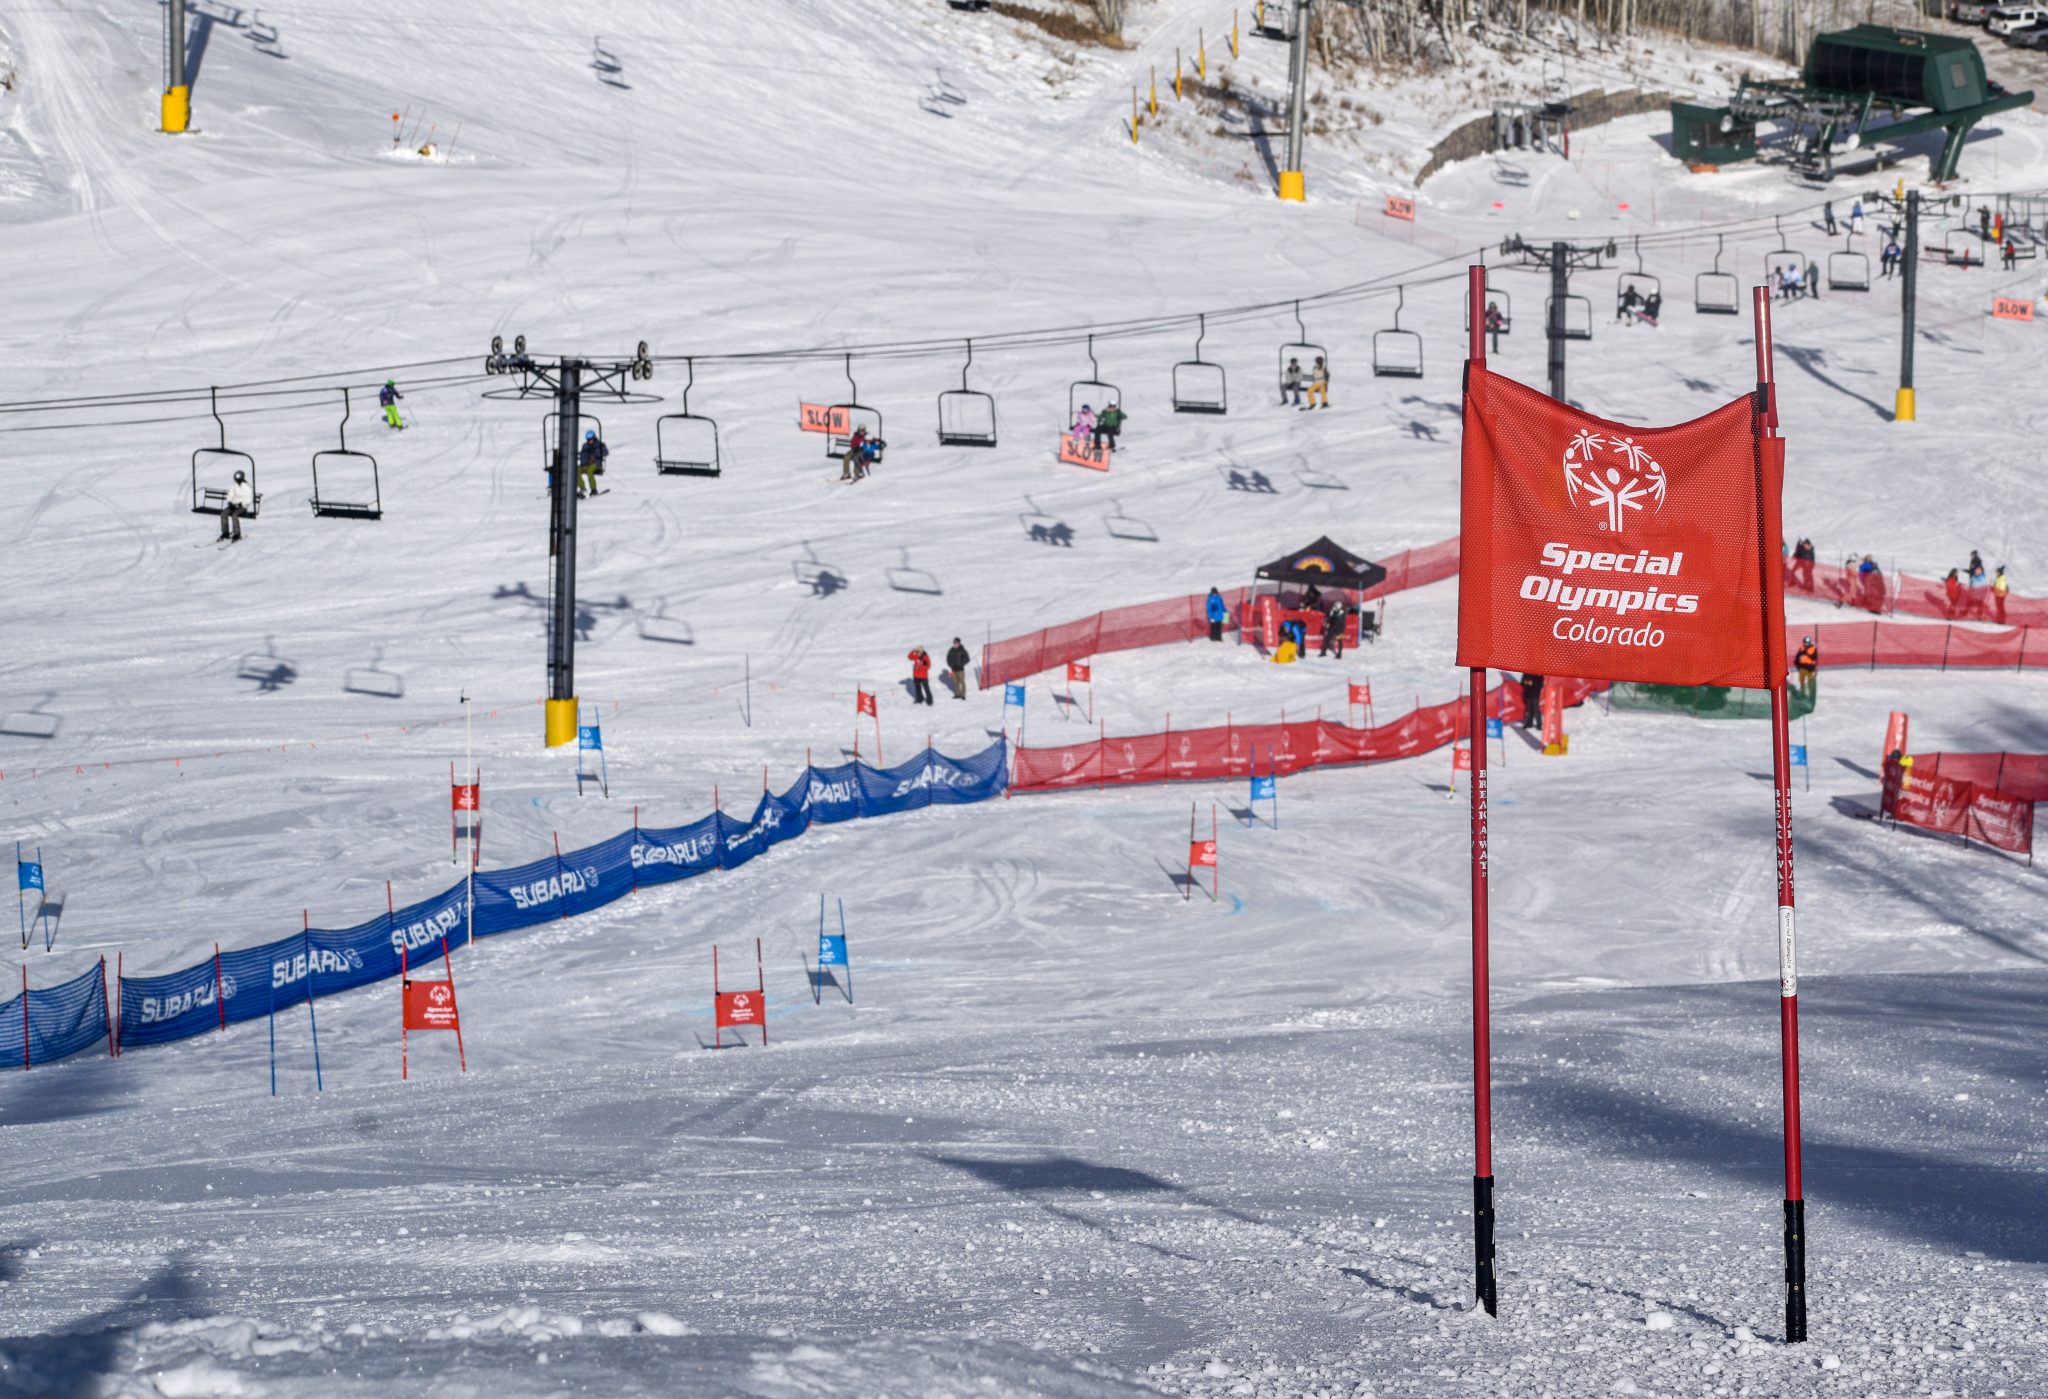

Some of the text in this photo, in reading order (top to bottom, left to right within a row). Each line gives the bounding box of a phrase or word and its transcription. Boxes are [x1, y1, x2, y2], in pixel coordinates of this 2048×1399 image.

[1998, 302, 2029, 316] SLOW
[807, 409, 843, 428] SLOW
[1068, 441, 1103, 463] SLOW
[1540, 542, 1683, 576] Special
[1519, 575, 1699, 615] Olympics
[1553, 617, 1665, 648] Colorado
[630, 838, 699, 869] SUBARU
[509, 870, 586, 909] SUBARU
[391, 902, 462, 954] SUBARU
[272, 950, 349, 988] SUBARU
[141, 979, 216, 1023] SUBARU
